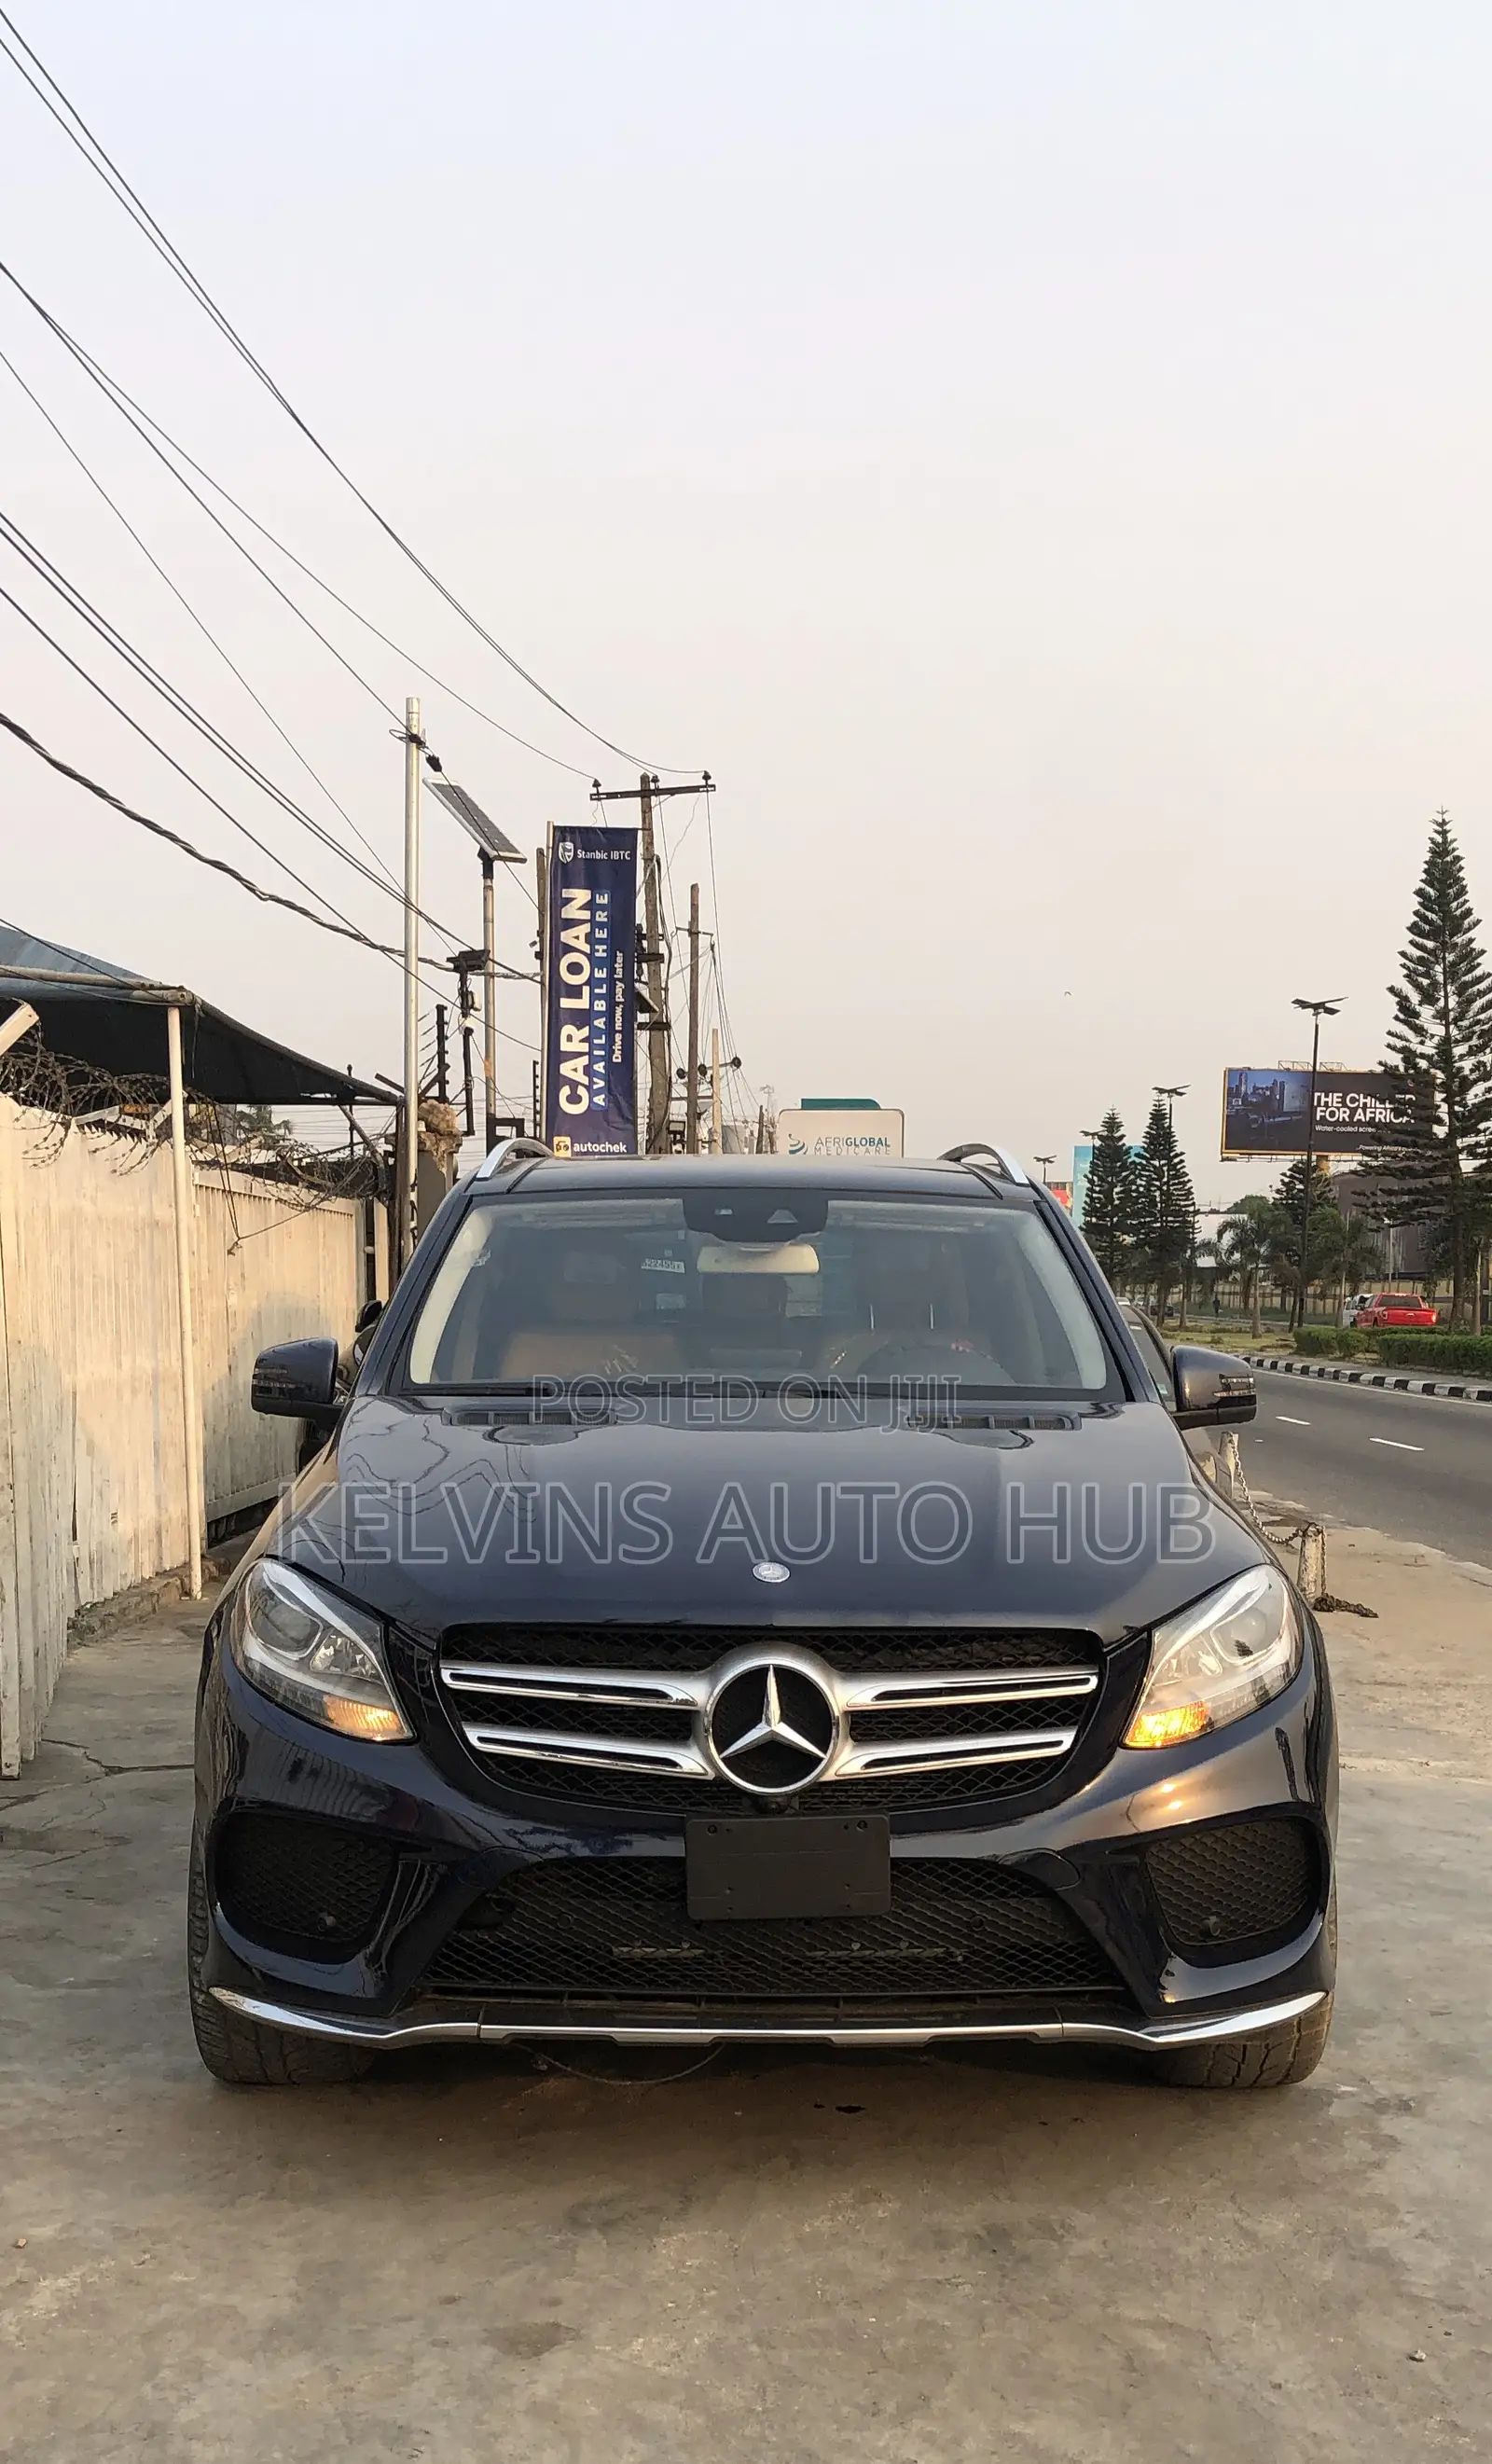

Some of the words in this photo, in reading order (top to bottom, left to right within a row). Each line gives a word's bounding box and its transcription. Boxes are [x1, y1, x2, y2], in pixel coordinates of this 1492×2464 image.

[577, 849, 608, 860] Stanbic
[610, 851, 631, 861] IBTC
[595, 893, 609, 958] HERE
[560, 888, 592, 1010] LOAN
[614, 950, 624, 978] later
[615, 981, 626, 1003] pay
[613, 1004, 624, 1031] now,
[592, 966, 608, 1107] AVAILABLE
[612, 1033, 623, 1063] Drive
[559, 1024, 589, 1115] CAR
[1314, 1092, 1343, 1107] THE
[1316, 1106, 1350, 1122] FOR
[573, 1142, 627, 1153] autochek
[814, 1146, 891, 1156] MEDICARE
[815, 1136, 891, 1148] AFRIGLOBAL
